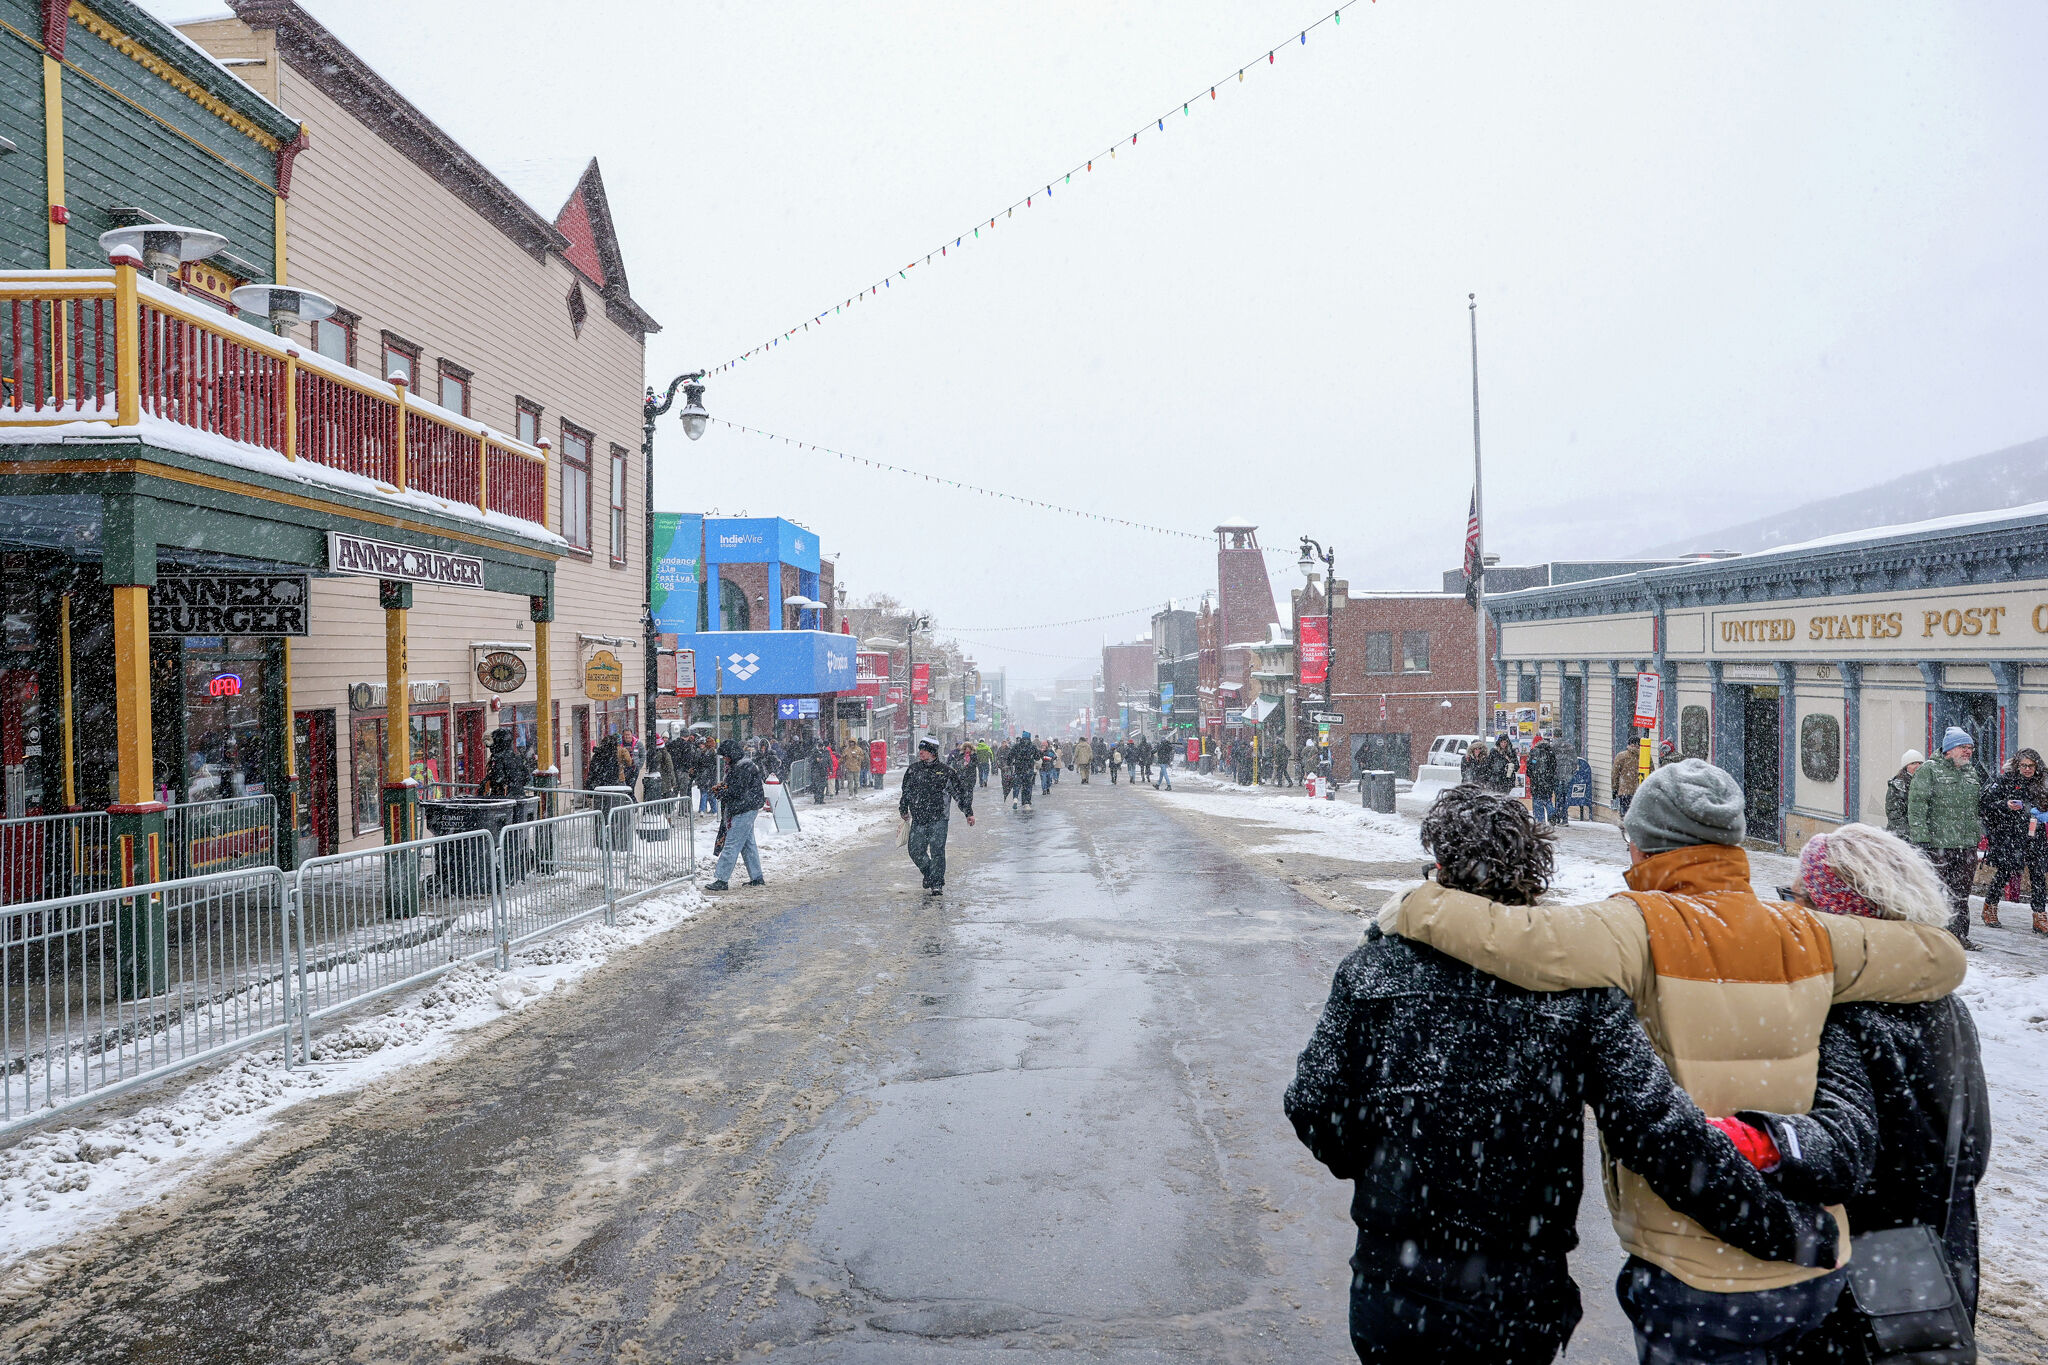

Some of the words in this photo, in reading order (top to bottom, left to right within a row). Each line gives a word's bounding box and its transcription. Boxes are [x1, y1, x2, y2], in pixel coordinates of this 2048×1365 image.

[720, 534, 763, 544] IndieWire
[338, 538, 411, 575] ANNEX
[413, 551, 482, 585] BURGER
[656, 556, 697, 565] Sundance
[656, 565, 676, 573] Film
[656, 573, 695, 582] Festival
[148, 578, 282, 606] ANNEX
[655, 582, 675, 591] 2025
[148, 606, 304, 633] BURGER
[1720, 618, 1796, 642] UNITED
[1808, 612, 1903, 640] STATES
[1921, 606, 2007, 637] POST
[1816, 666, 1831, 679] 450
[209, 678, 240, 696] OPEN
